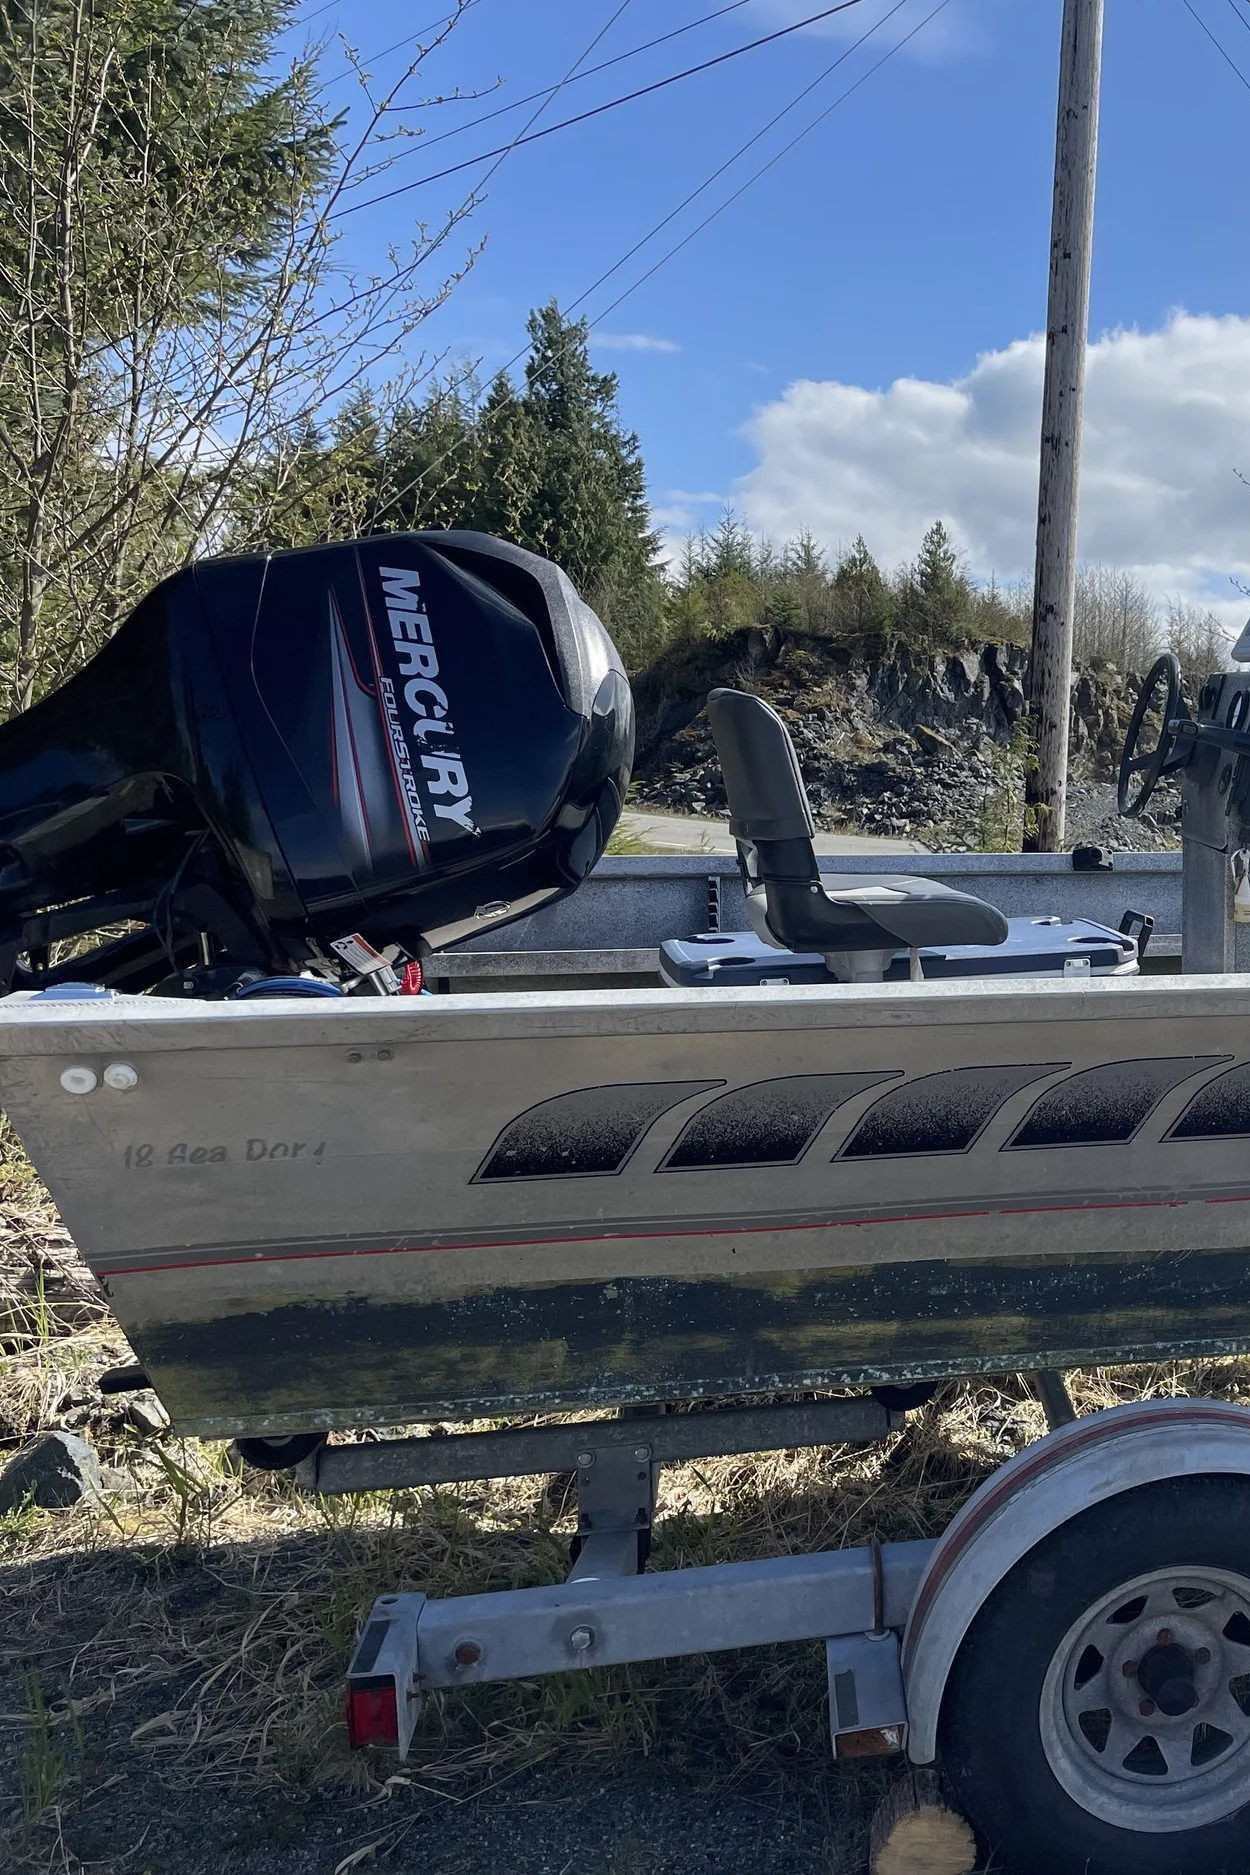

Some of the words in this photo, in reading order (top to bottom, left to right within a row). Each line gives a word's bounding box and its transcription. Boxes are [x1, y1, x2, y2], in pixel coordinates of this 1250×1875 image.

[379, 566, 482, 838] MERCURY
[380, 677, 430, 842] FOURSTROKE
[124, 1143, 154, 1169] 18
